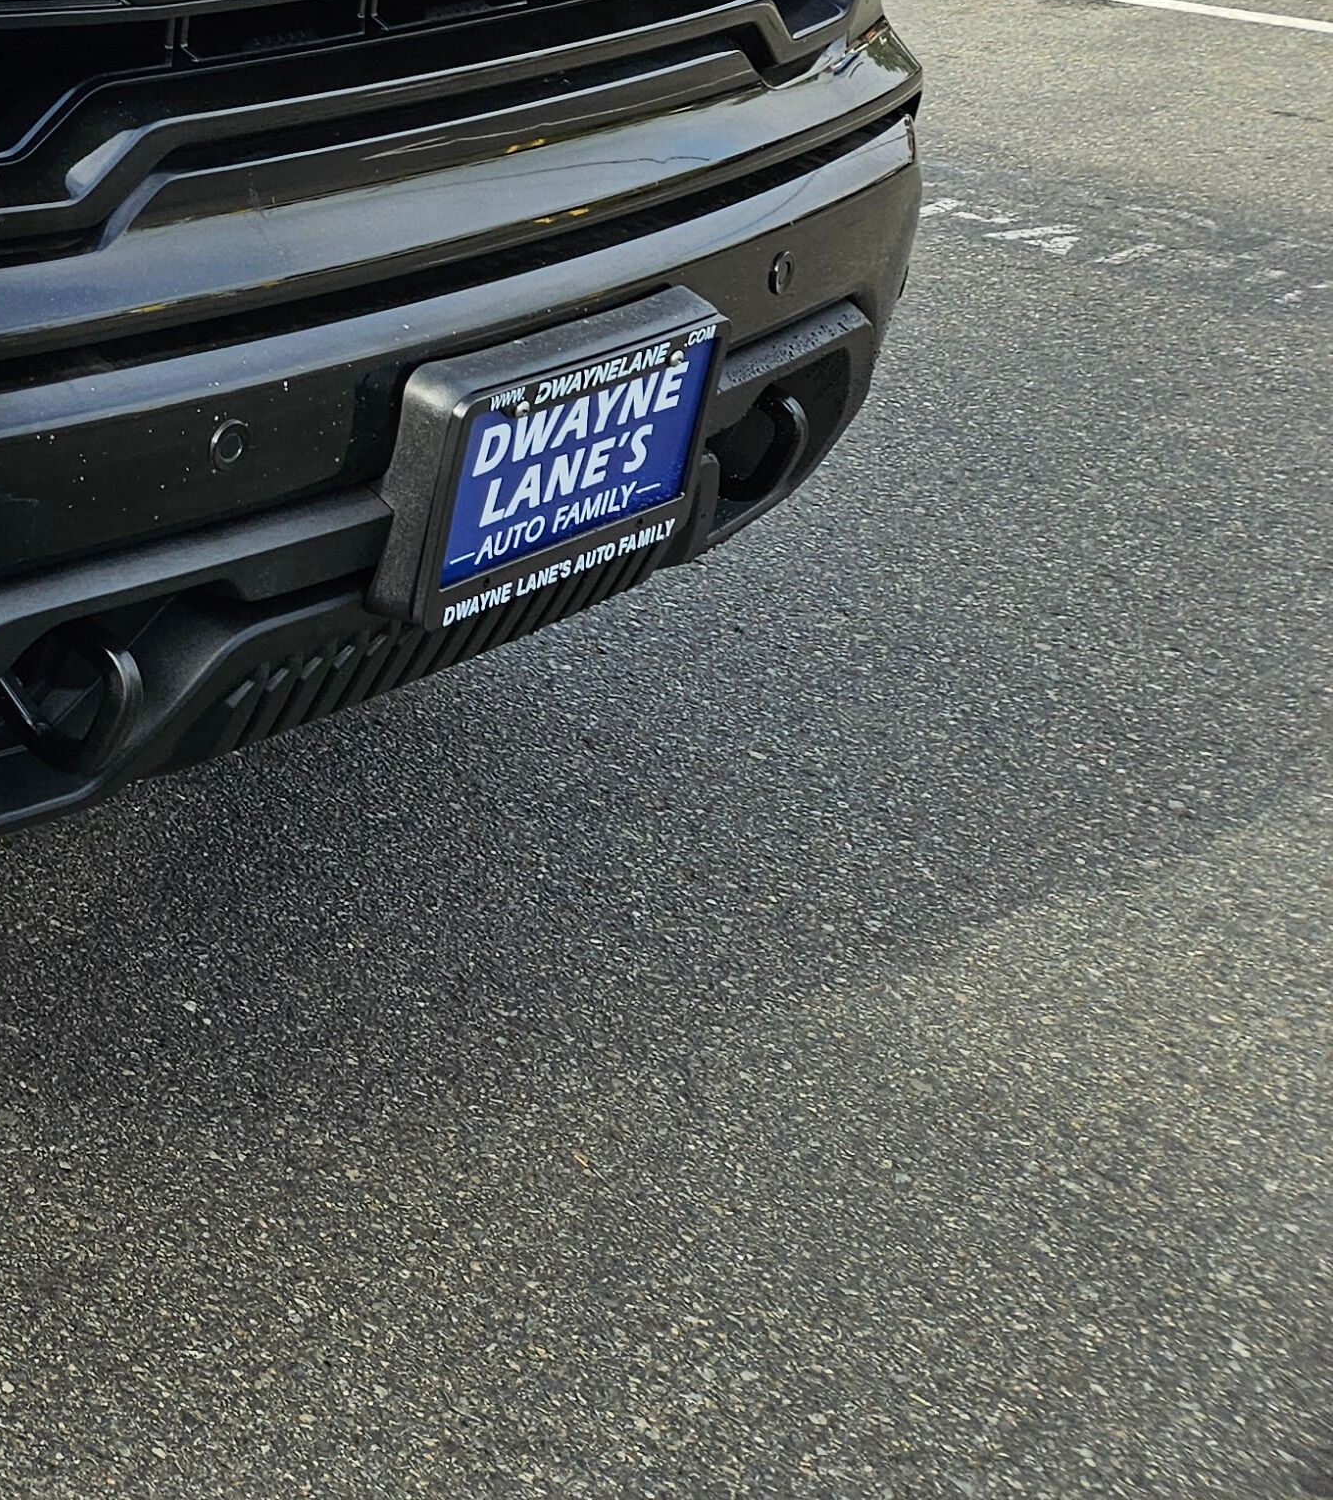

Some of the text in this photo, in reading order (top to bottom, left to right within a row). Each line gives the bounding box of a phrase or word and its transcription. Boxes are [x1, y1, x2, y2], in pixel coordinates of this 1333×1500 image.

[472, 362, 689, 477] DWAYNE
[534, 342, 670, 405] DWAYNELANE
[474, 481, 638, 565] AUTO FAMILY
[479, 424, 653, 527] LANE'S
[442, 518, 676, 627] DWAYNE LANE'S AUTO FAMILY
